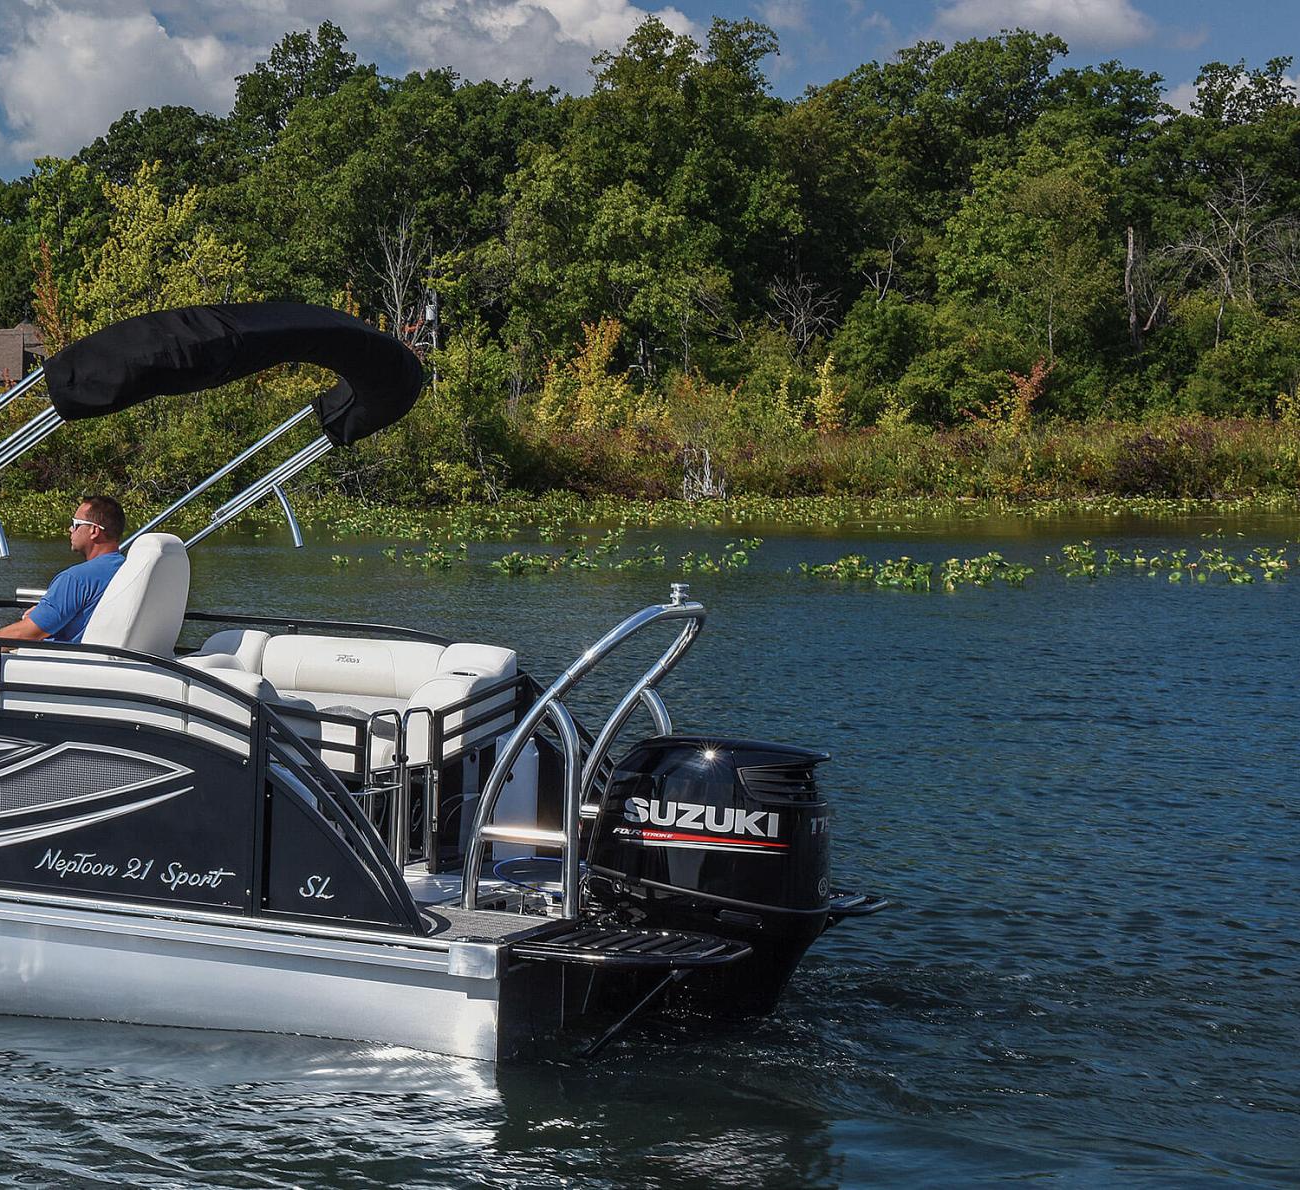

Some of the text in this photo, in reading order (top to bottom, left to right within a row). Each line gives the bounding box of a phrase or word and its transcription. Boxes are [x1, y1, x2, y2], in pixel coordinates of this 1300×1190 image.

[623, 797, 780, 838] SUZUKI
[35, 849, 236, 891] NepToon 21 Sport
[299, 876, 335, 900] SL
